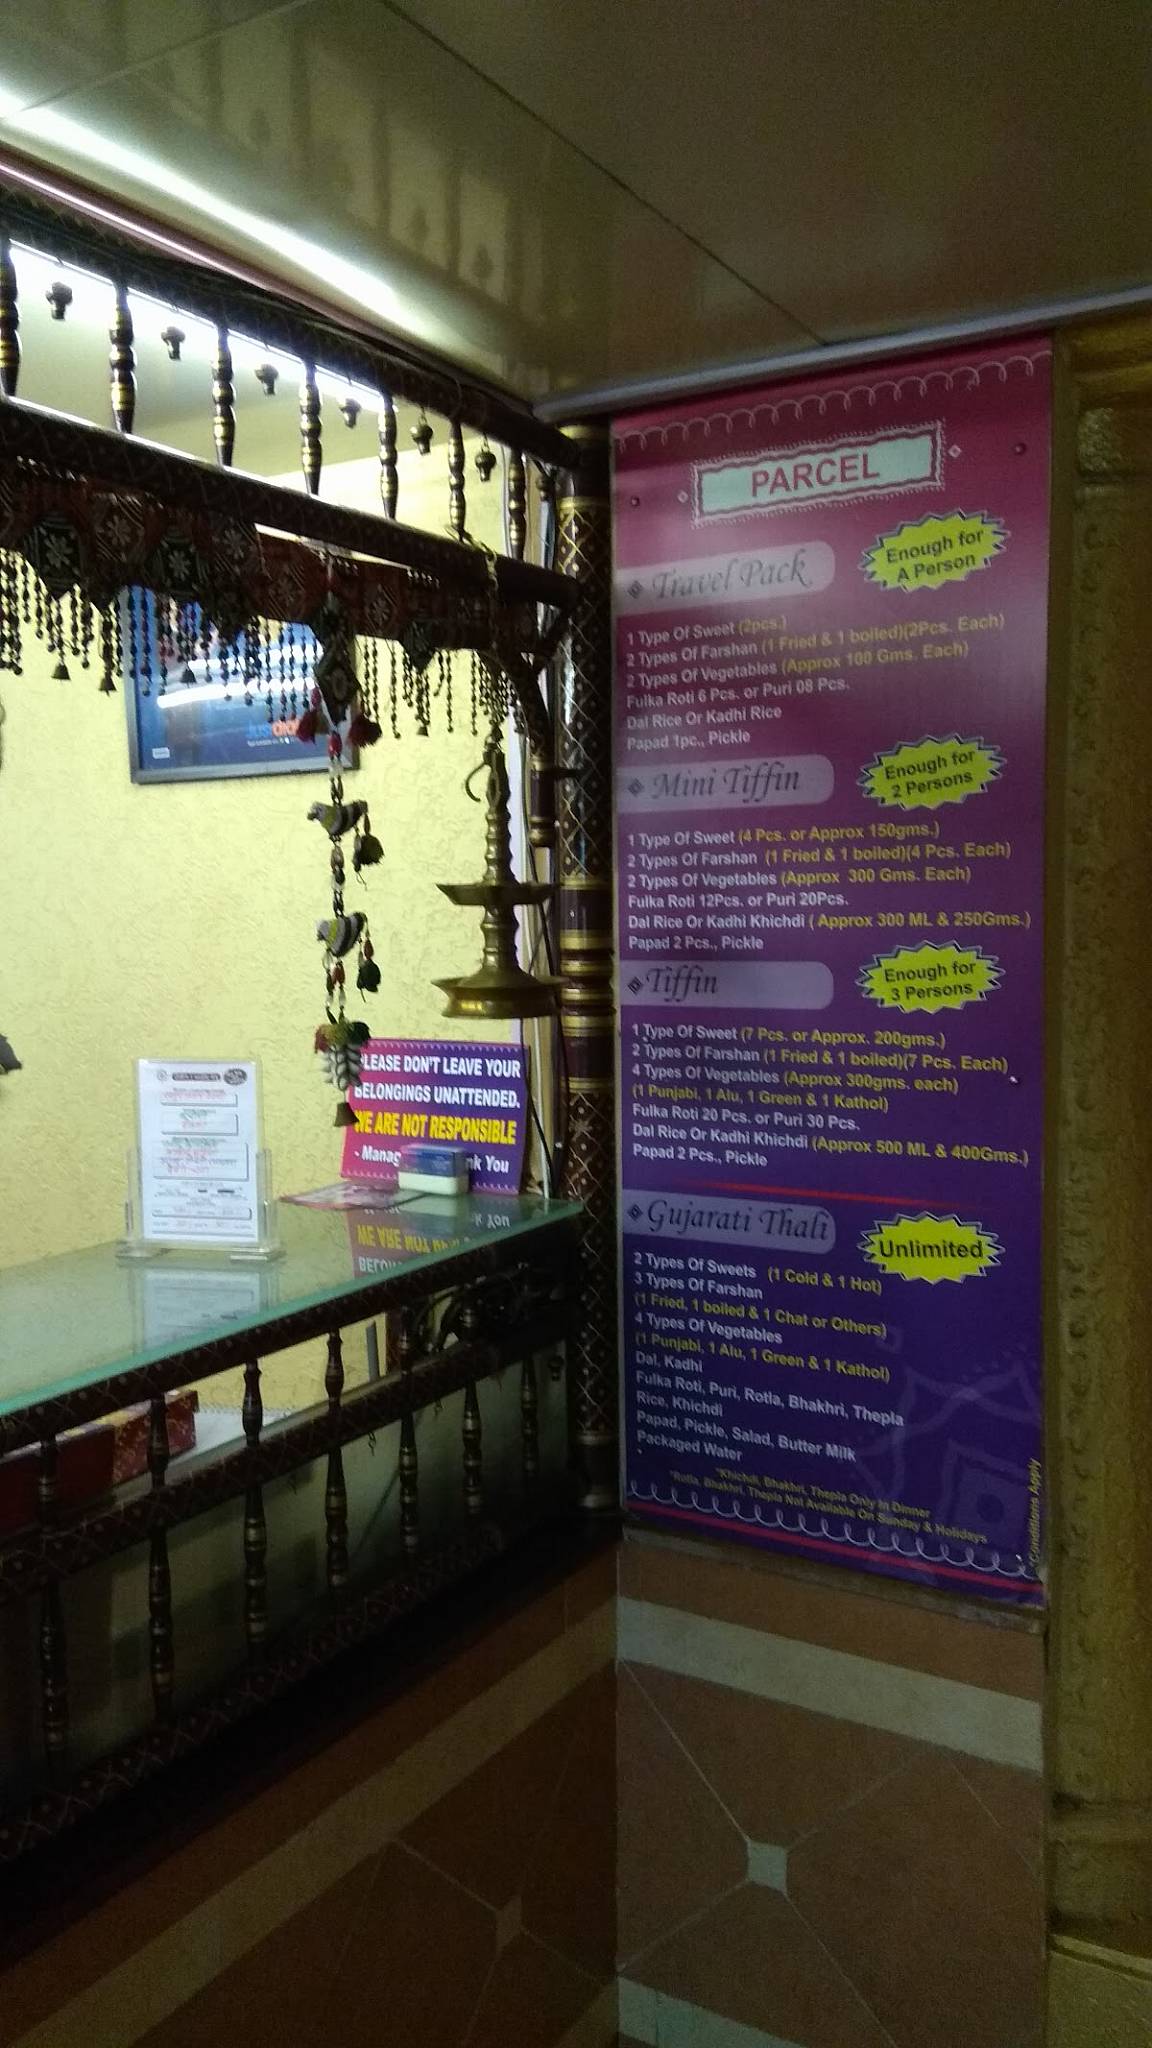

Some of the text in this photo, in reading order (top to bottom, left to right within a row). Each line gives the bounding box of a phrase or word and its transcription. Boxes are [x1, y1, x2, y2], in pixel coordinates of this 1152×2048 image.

[751, 452, 880, 497] PARCEL
[886, 529, 983, 565] Enough for
[652, 547, 813, 601] Travel Pack
[913, 553, 976, 580] Person
[639, 631, 668, 646] Type
[694, 622, 735, 639] Sweet
[640, 652, 677, 668] Types
[702, 643, 757, 659] Farshan
[779, 634, 816, 649] Fried
[640, 672, 677, 689] Types
[701, 662, 777, 682] Vegetables
[848, 652, 872, 667] 100
[627, 695, 663, 709] Fulka
[667, 691, 694, 706] Roti
[763, 682, 791, 696] Puri
[627, 705, 782, 730] Dal Rice Kadhi Rice
[627, 736, 669, 753] Papad
[708, 730, 751, 744] Pickle
[885, 749, 974, 780] Enough for
[653, 762, 801, 805] Mini Tiffin
[905, 771, 974, 796] Persons
[640, 833, 670, 848] Type
[694, 831, 735, 844] Sweet
[809, 826, 864, 841] Approx
[640, 854, 677, 870] Types
[702, 851, 757, 865] Farshan
[783, 849, 820, 863] Fried
[640, 874, 677, 890] Types
[701, 871, 777, 889] Vegetables
[849, 868, 875, 882] 300
[629, 896, 664, 909] Fulka
[668, 895, 695, 907] Roti
[767, 893, 795, 906] Puri
[629, 913, 904, 929] Dal Rice Kadhi Khichdi 300
[629, 936, 669, 952] Papad
[722, 936, 763, 949] Pickle
[646, 967, 720, 1003] Tiffin
[884, 961, 975, 987] Enough for
[905, 981, 974, 1000] Persons
[644, 1024, 674, 1040] Type
[696, 1026, 738, 1040] Sweet
[645, 1044, 682, 1059] Types
[704, 1047, 760, 1062] Farshan
[781, 1049, 817, 1063] Fried
[404, 1055, 441, 1074] DON'T
[443, 1059, 482, 1077] LEAVE
[486, 1059, 520, 1078] YOUR
[644, 1064, 682, 1081] Types
[704, 1067, 780, 1083] Vegetables
[354, 1085, 431, 1103] BELONGINGS
[759, 1091, 801, 1105] Green
[633, 1104, 668, 1118] Fulka
[672, 1106, 698, 1120] Roti
[774, 1112, 802, 1127] Puri
[374, 1113, 400, 1134] ARE
[401, 1114, 428, 1138] NOT
[430, 1115, 516, 1144] RESPONSIBLE
[633, 1124, 903, 1155] Dal Rice Kadhi Khichdi 500
[485, 1155, 509, 1174] You
[633, 1144, 674, 1160] Papad
[726, 1150, 767, 1166] Pickle
[646, 1198, 830, 1242] Gujarati Thali
[879, 1239, 984, 1260] Unlimited
[646, 1253, 818, 1285] Types Sweets Cold
[646, 1273, 763, 1299] Types Farshan
[704, 1300, 744, 1317] boiled
[775, 1309, 808, 1326] Chat
[647, 1312, 783, 1344] Types Vegetables
[664, 1355, 703, 1373] Kadhi
[762, 1349, 804, 1368] Green
[636, 1370, 672, 1388] Fulka
[852, 1404, 904, 1427] Thepla
[672, 1396, 723, 1417] Khichdi
[637, 1430, 743, 1461] Packaged Water
[777, 1435, 823, 1456] Butter
[826, 1443, 856, 1461] Milk
